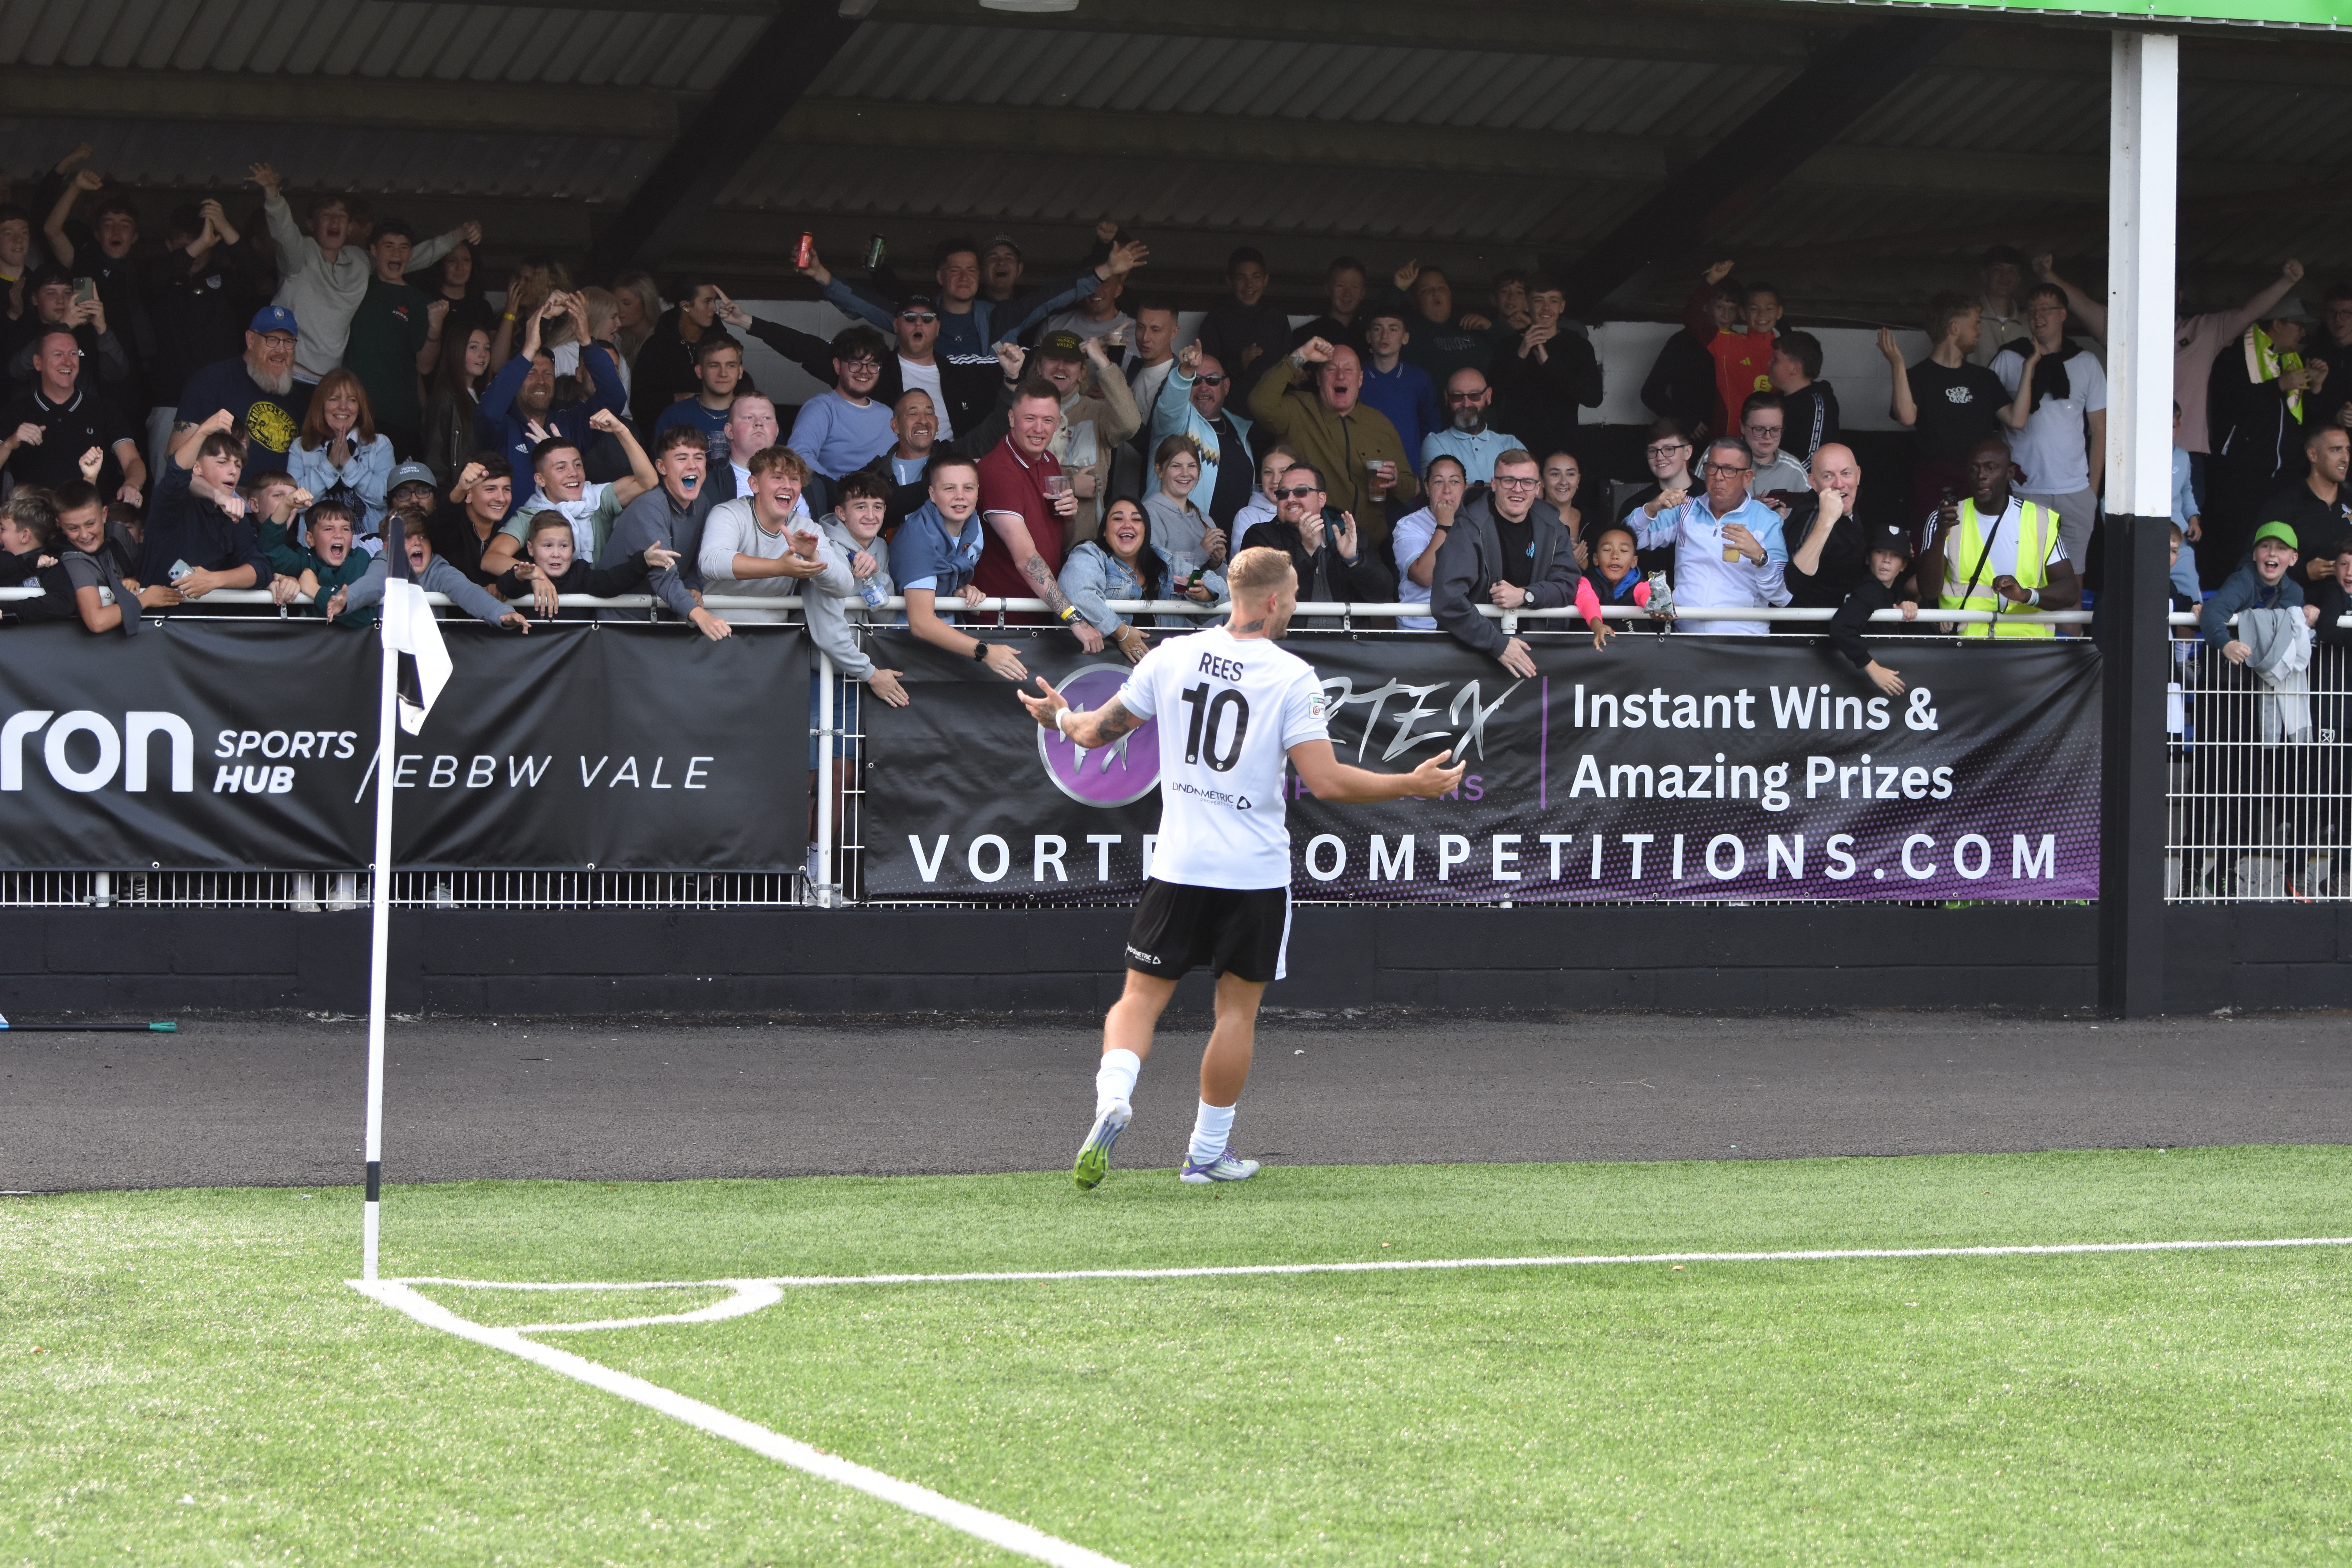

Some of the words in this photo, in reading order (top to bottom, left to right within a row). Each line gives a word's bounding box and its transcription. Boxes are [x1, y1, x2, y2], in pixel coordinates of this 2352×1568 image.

[1198, 652, 1244, 682] REES
[1574, 684, 1755, 728] Instant
[1769, 684, 1890, 730] Wins
[1905, 687, 1938, 731] &
[1181, 682, 1249, 772] 10
[214, 730, 357, 759] SPORTS
[213, 765, 295, 793] HUB
[393, 755, 552, 788] EBBW
[580, 756, 714, 789] VALE
[1569, 753, 1790, 811] Amazing
[1806, 754, 1953, 799] Prizes
